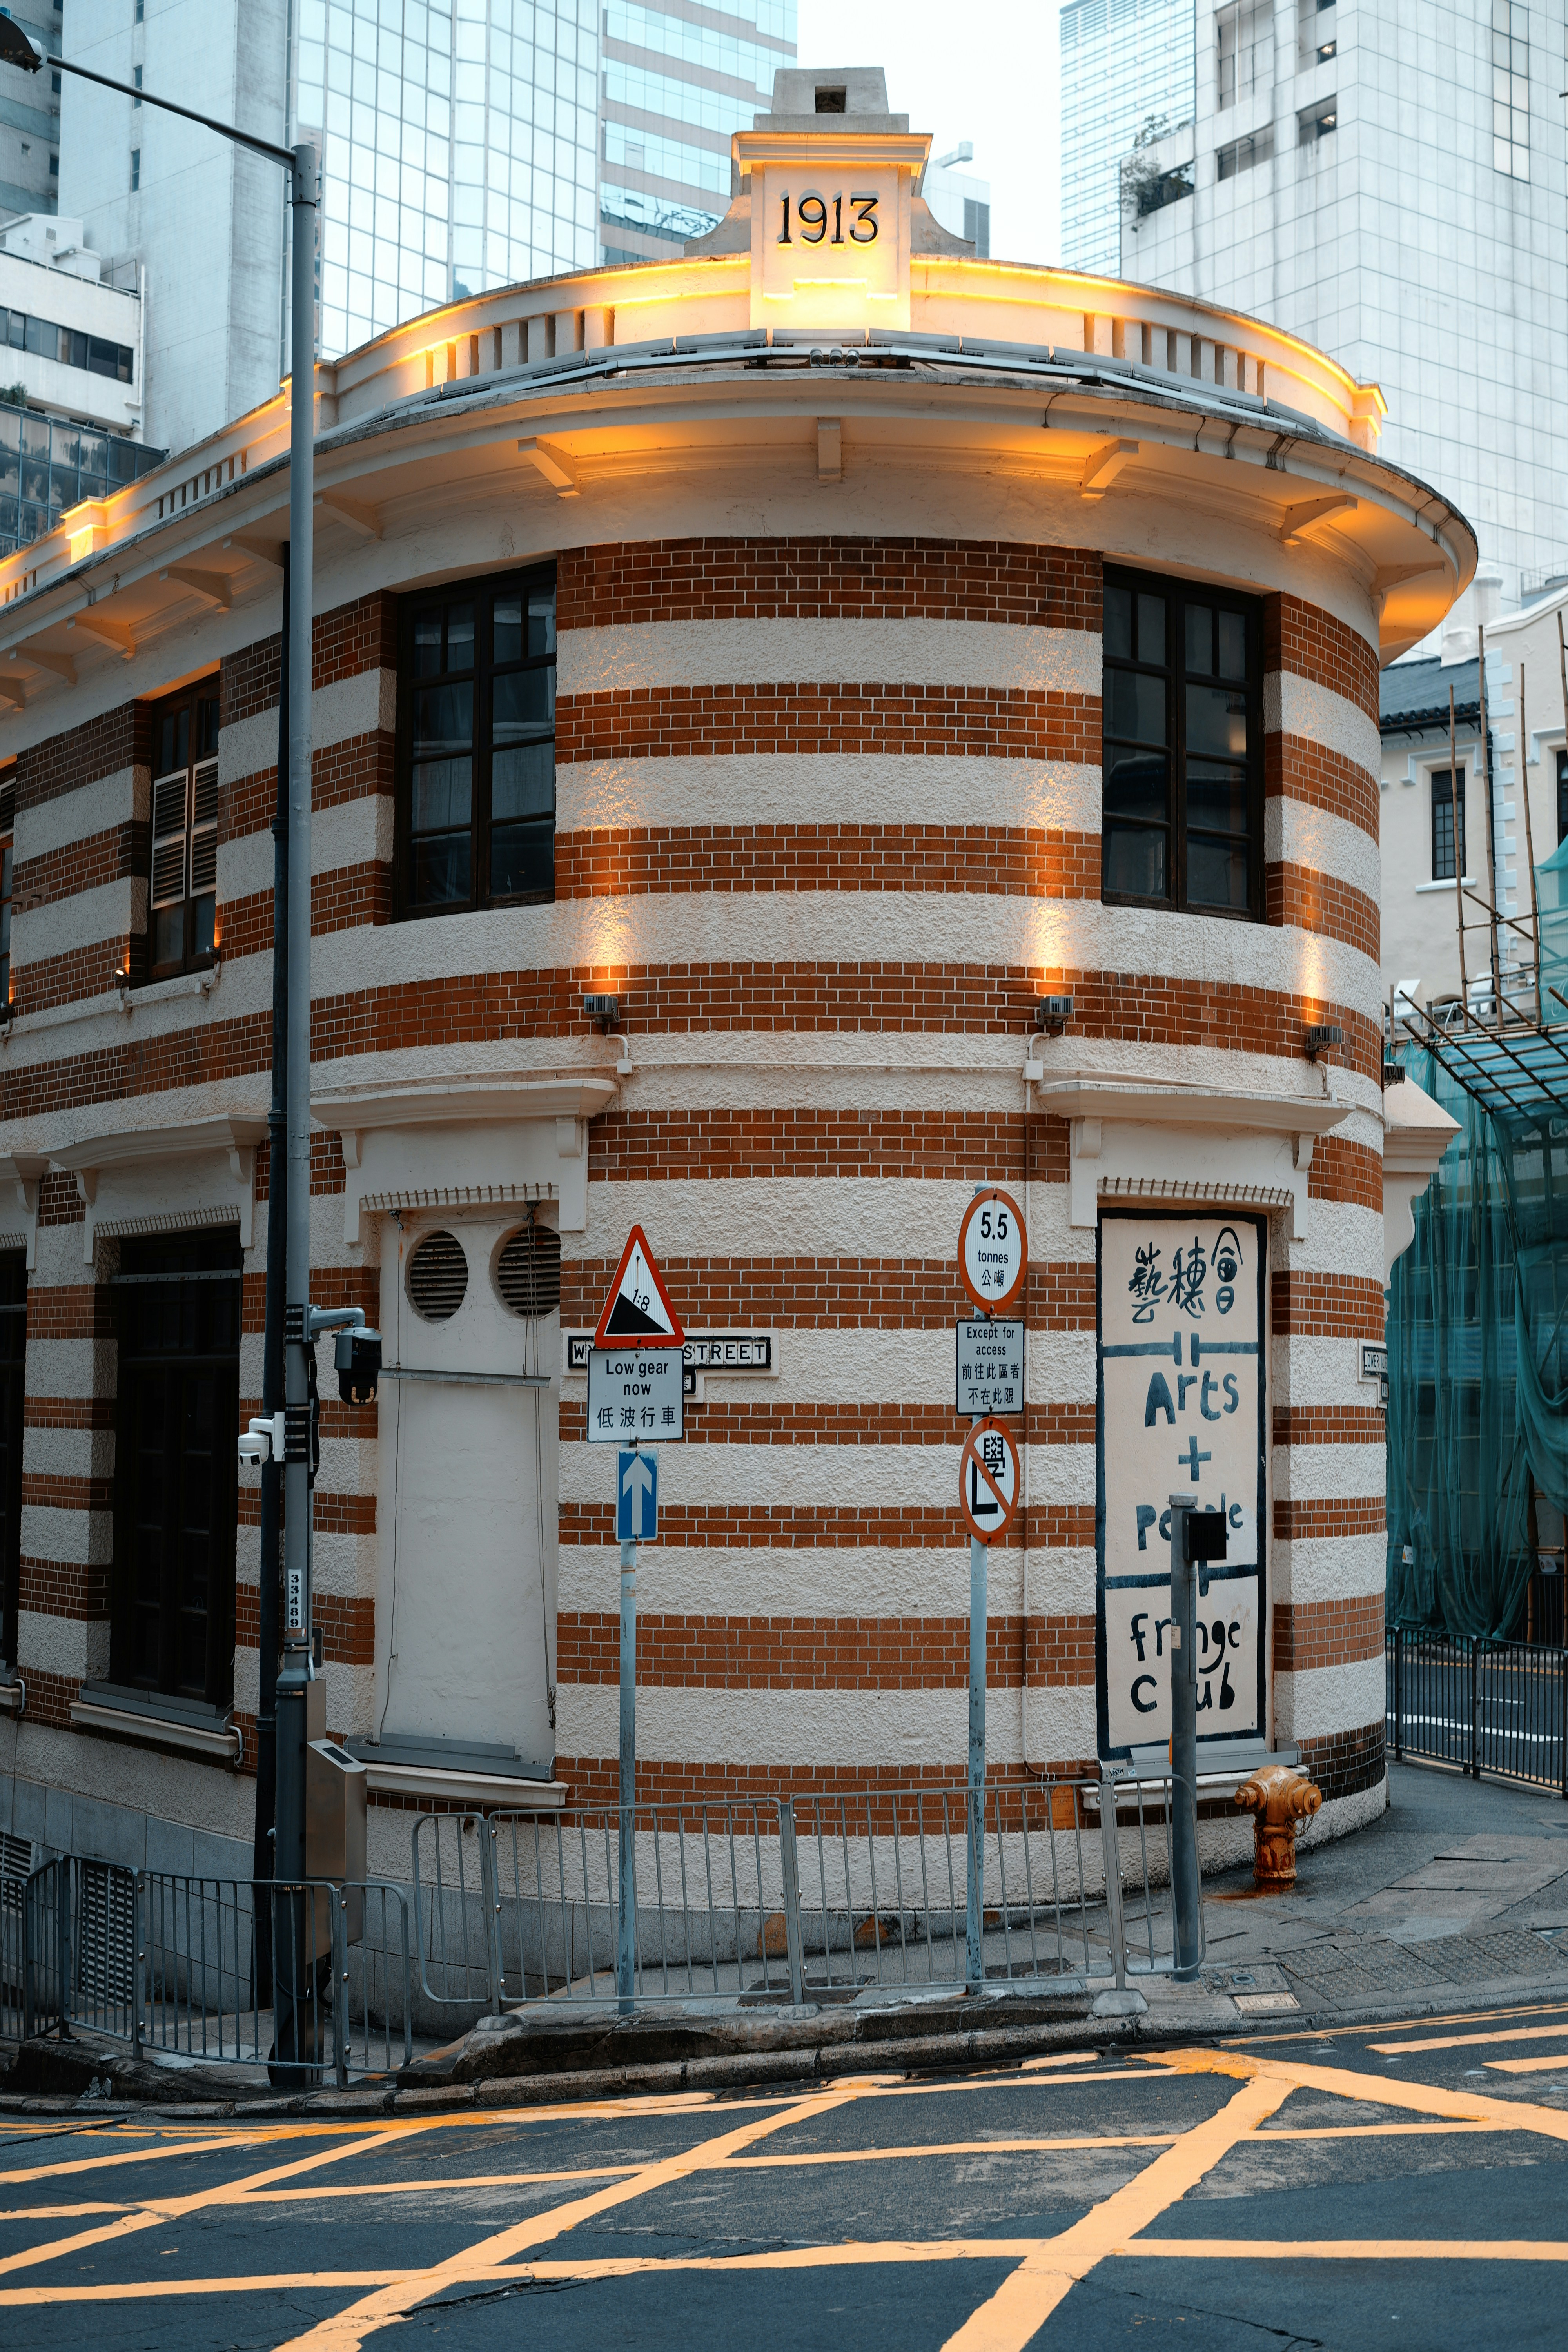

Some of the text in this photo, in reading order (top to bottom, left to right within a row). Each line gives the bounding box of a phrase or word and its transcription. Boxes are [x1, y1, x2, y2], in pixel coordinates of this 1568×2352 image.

[777, 192, 879, 245] 1913
[981, 1211, 1007, 1240] 5.5
[978, 1249, 1009, 1264] tonnes
[982, 1269, 1004, 1287] 公噸
[632, 1288, 650, 1312] 1:8
[967, 1326, 1015, 1341] Except for
[683, 1344, 766, 1360] STREET
[976, 1345, 1006, 1356] access
[606, 1359, 669, 1378] Low gear
[1364, 1352, 1379, 1368] LOWER
[962, 1362, 1020, 1380] 前往此區者
[623, 1383, 652, 1396] now
[968, 1387, 1014, 1405] 不在此限
[1145, 1370, 1239, 1427] Arts
[597, 1405, 676, 1428] 低波行車
[972, 1461, 998, 1515] L
[290, 1574, 299, 1627] 33489
[1130, 1613, 1241, 1674] frnge
